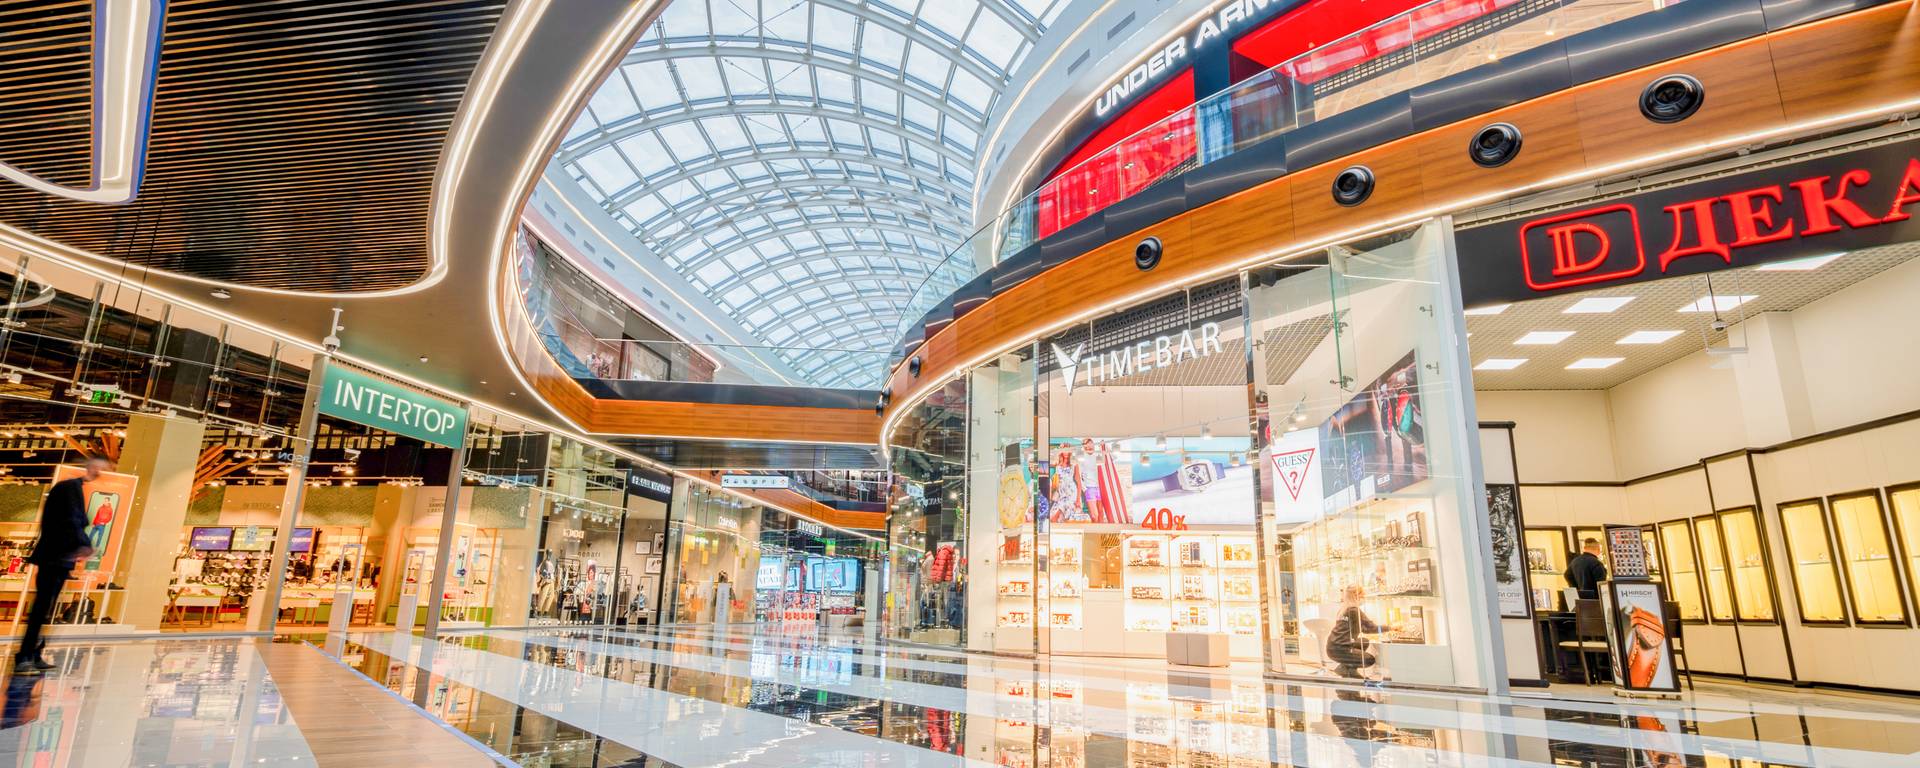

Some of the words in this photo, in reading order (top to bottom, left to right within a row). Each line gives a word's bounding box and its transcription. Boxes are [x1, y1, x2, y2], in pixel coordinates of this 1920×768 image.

[1096, 36, 1186, 116] UNDER
[1081, 321, 1224, 386] TIMEBAR
[334, 379, 456, 435] INTERTOP
[1277, 453, 1308, 468] GUESS
[1141, 508, 1188, 530] 40%
